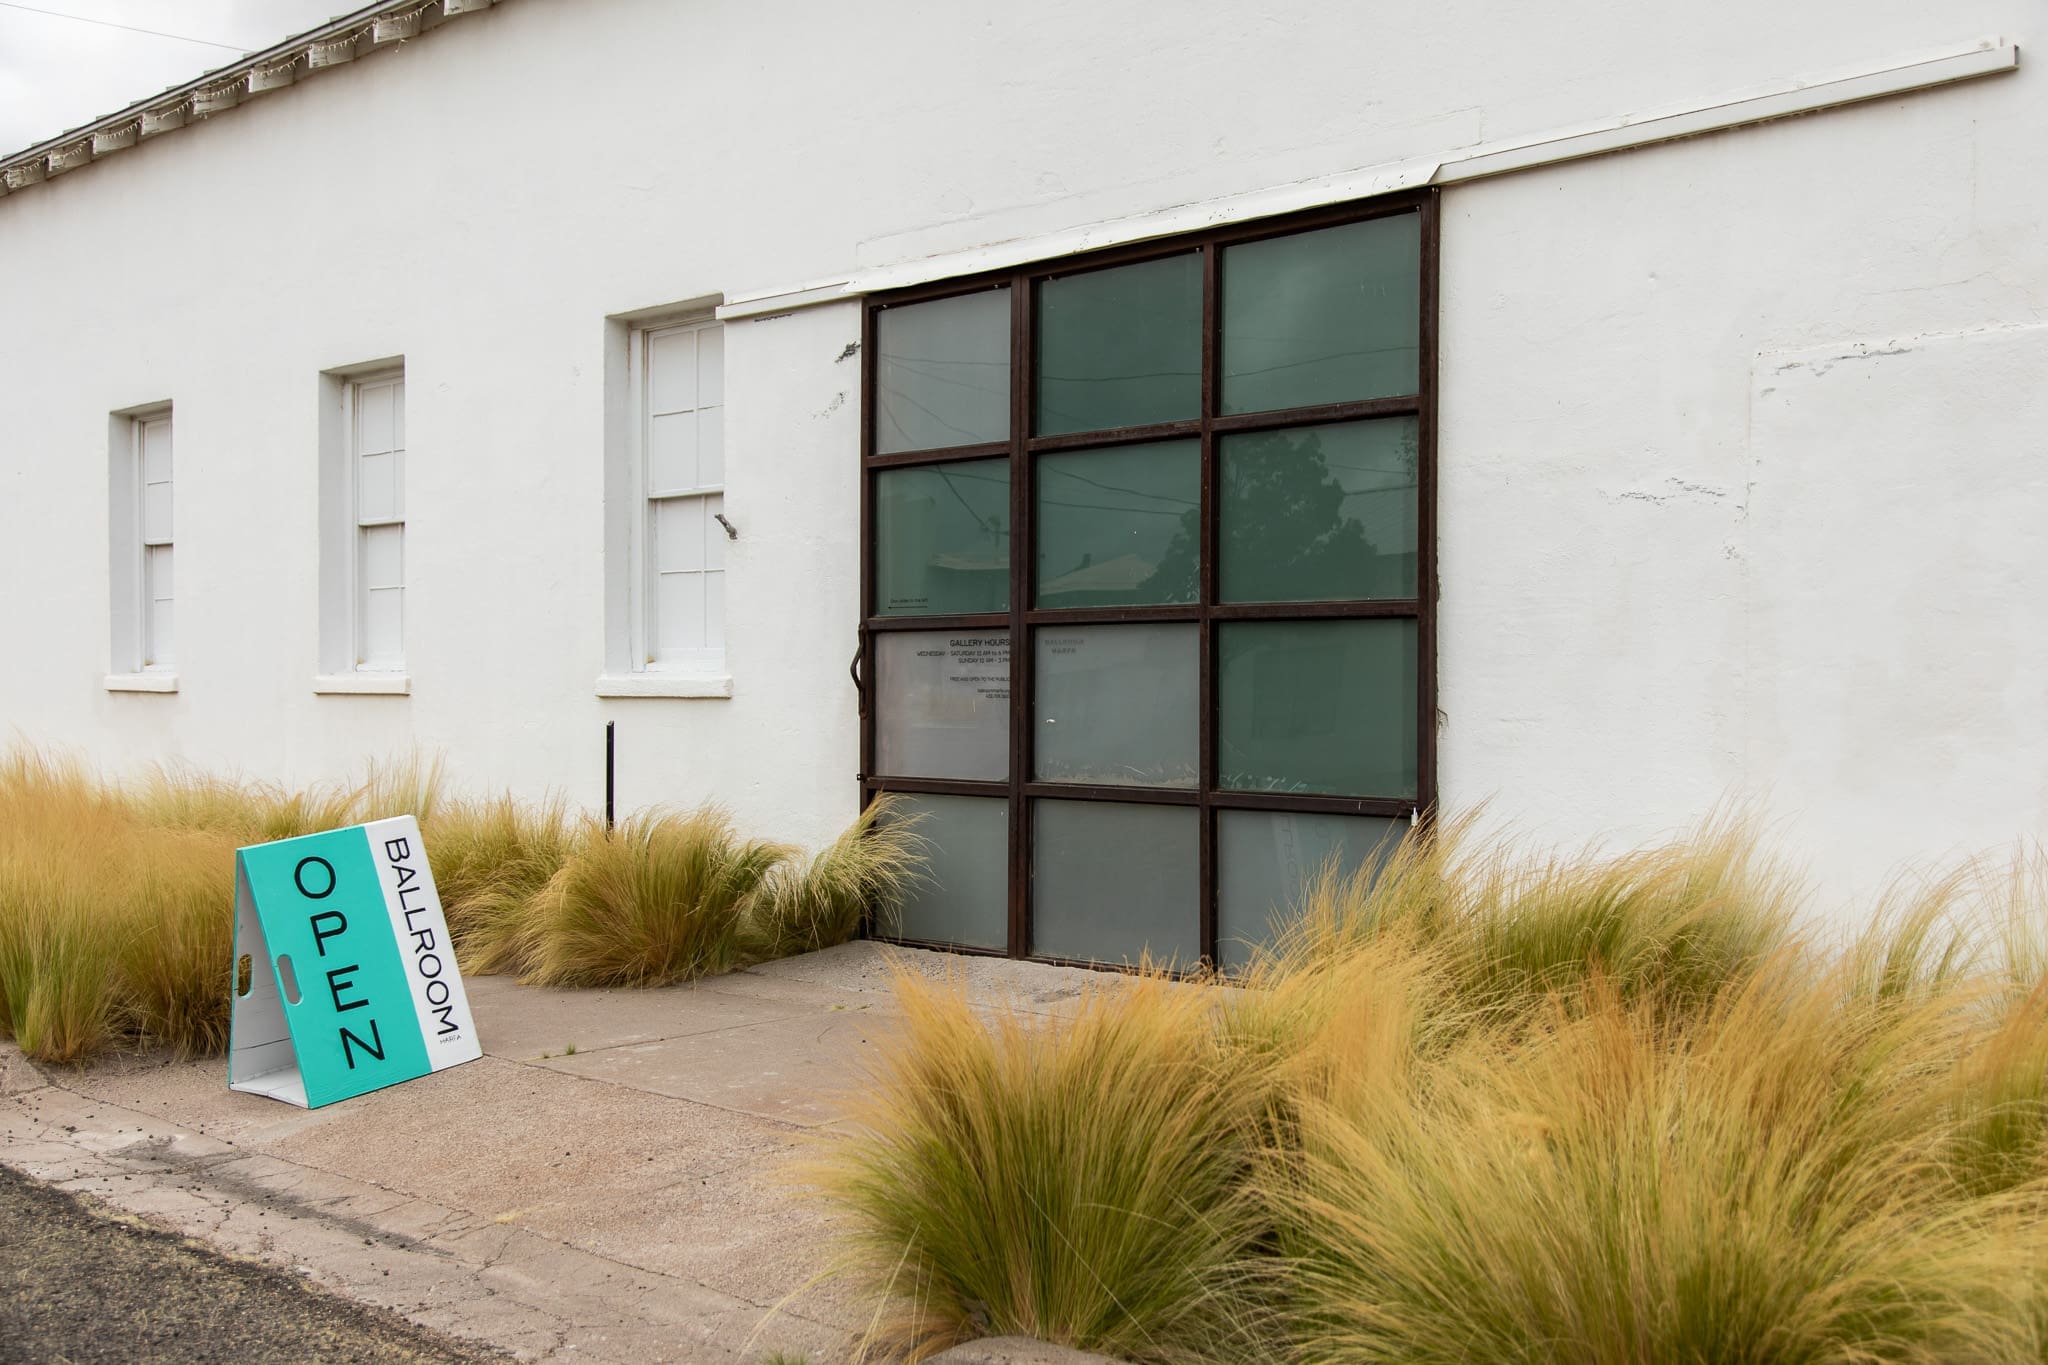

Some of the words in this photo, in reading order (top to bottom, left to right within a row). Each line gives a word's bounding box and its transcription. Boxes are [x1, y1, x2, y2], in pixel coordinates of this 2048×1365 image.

[950, 639, 983, 647] GALLERY
[985, 638, 1010, 646] HOURS
[294, 856, 386, 1069] OPEN
[385, 837, 459, 1036] BALLROOM
[439, 1034, 462, 1045] MARFA
